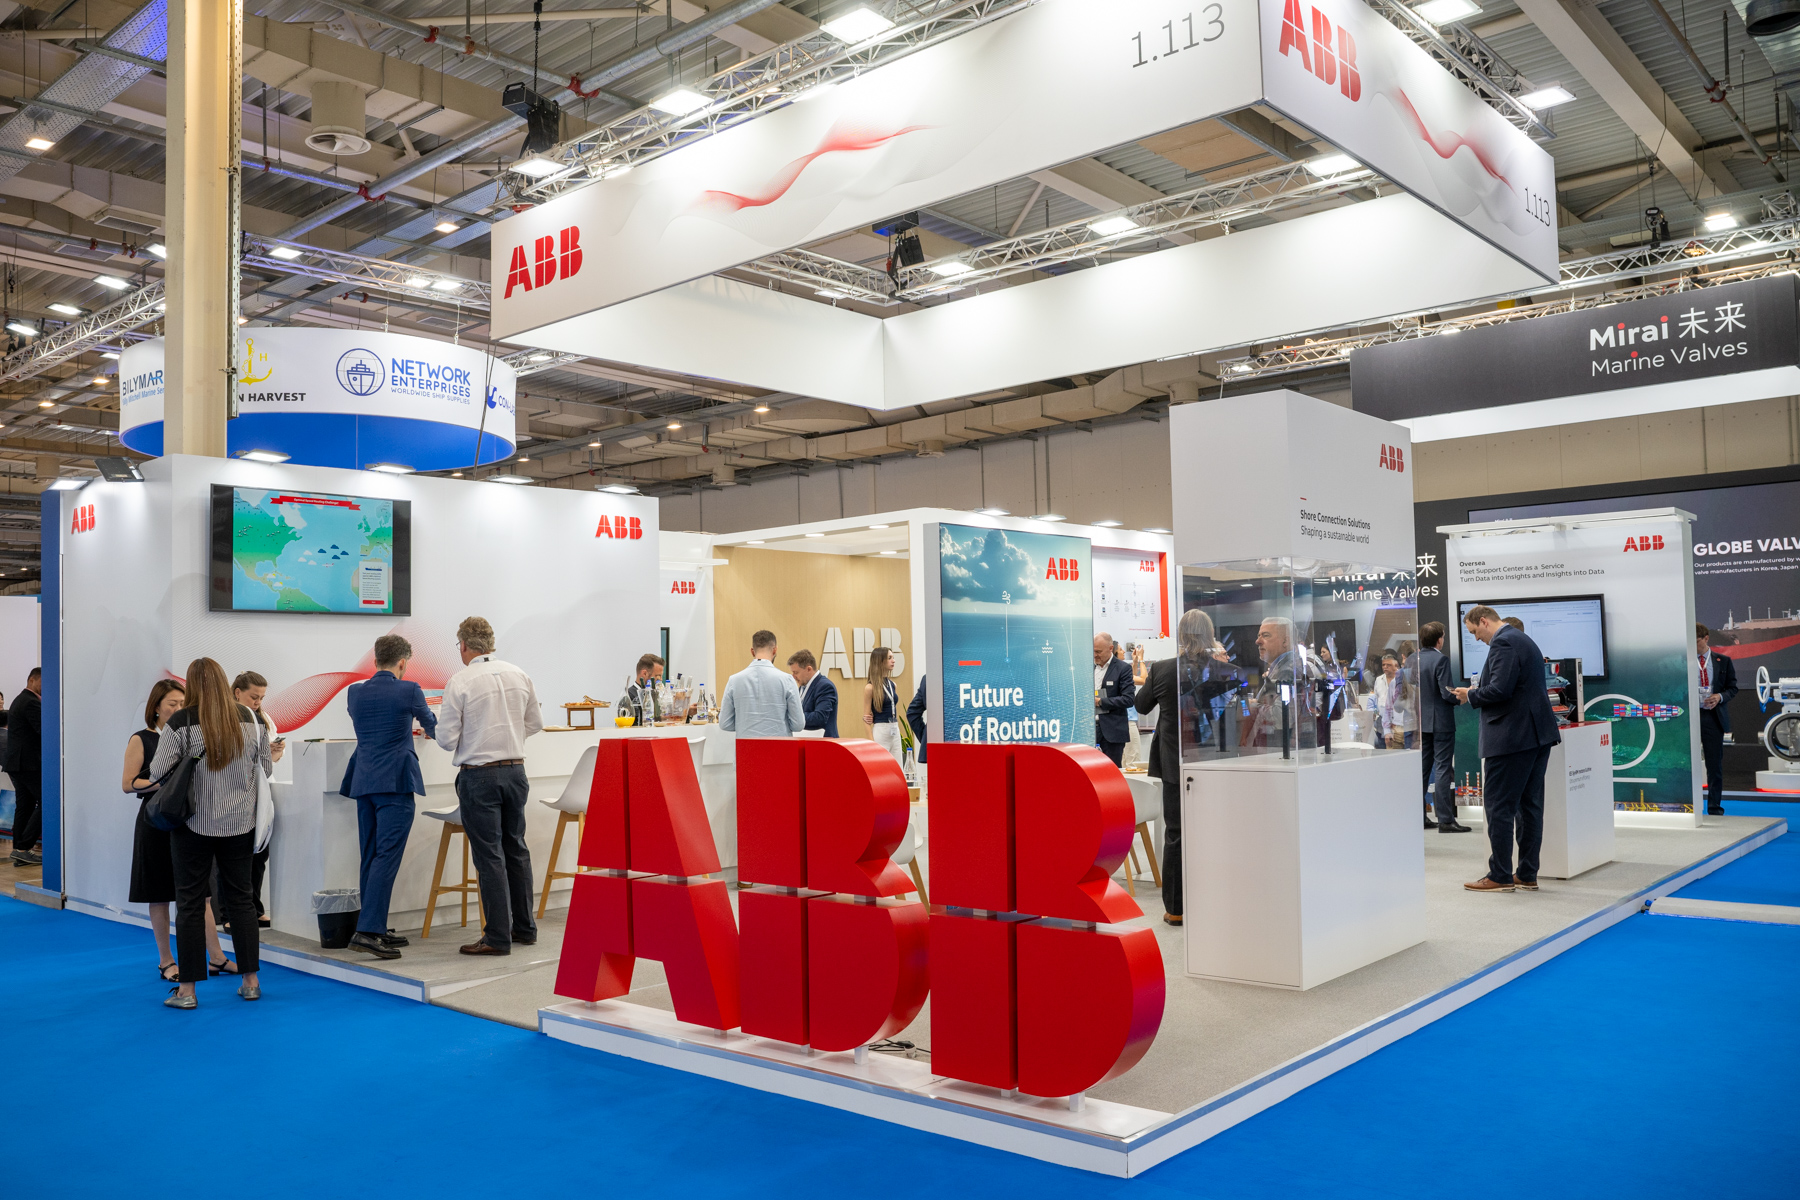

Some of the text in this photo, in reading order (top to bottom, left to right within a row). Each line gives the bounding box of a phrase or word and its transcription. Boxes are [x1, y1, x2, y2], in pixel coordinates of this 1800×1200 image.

[1131, 3, 1225, 68] 1.113
[1279, 0, 1361, 102] ABB
[1524, 186, 1551, 228] 1.113
[504, 225, 583, 299] ABB
[1590, 301, 1747, 351] Mirai 未来
[259, 352, 268, 362] H
[1592, 341, 1748, 377] Marine Valves
[122, 369, 164, 397] BILYMAR
[391, 357, 471, 387] NETWORK
[248, 392, 306, 402] HARVEST
[390, 387, 471, 405] WORLDWIDE SHIP SUPPLIES
[391, 375, 471, 398] ENTERPRISES
[1379, 443, 1405, 473] ABB
[71, 503, 96, 535] ABB
[595, 514, 643, 540] ABB
[1300, 509, 1371, 530] Shore Connection Solutions
[1300, 525, 1370, 544] Shaping a sustainable world
[1623, 535, 1665, 552] ABB
[1693, 536, 1800, 556] GLOBE VALV
[1045, 556, 1080, 582] ABB
[1139, 560, 1155, 572] ABB
[1475, 567, 1502, 575] Support
[1502, 565, 1524, 573] Center
[1540, 562, 1565, 570] Service
[1743, 557, 1786, 565] manufactured
[670, 580, 696, 595] ABB
[1505, 573, 1531, 581] Insights
[1545, 571, 1573, 579] Insights
[1332, 584, 1439, 602] Marine Valves
[819, 627, 905, 679] ABB
[959, 683, 1024, 709] Future
[959, 713, 1061, 743] of Routing
[553, 736, 1166, 1098] ABB
